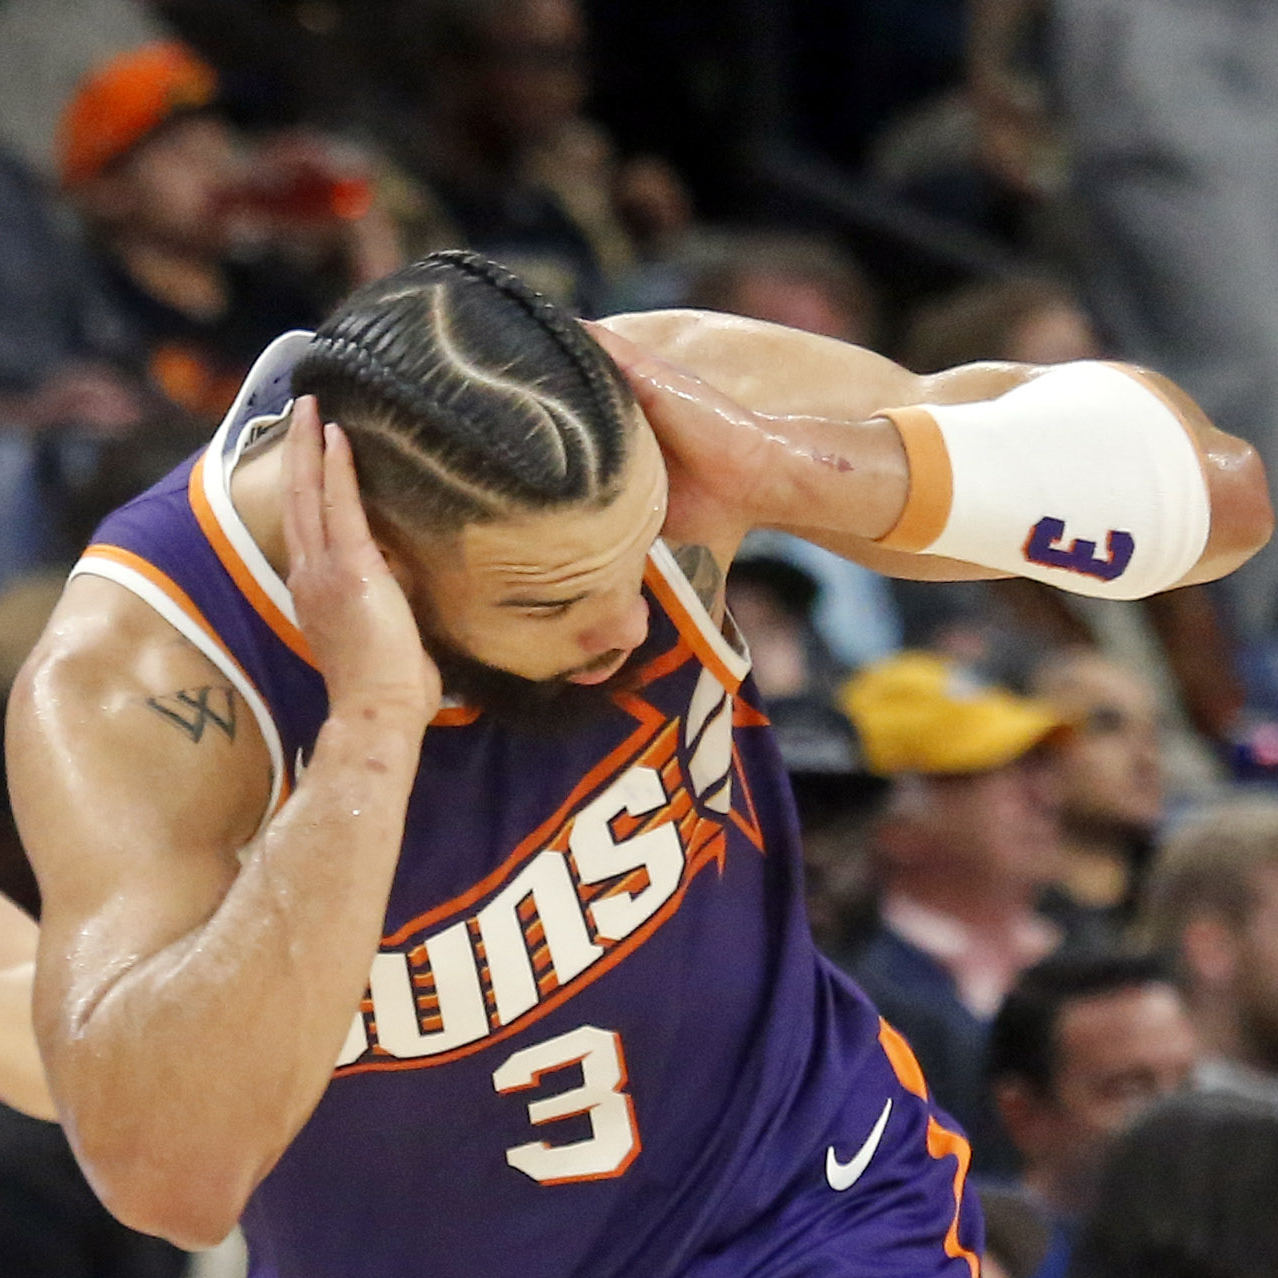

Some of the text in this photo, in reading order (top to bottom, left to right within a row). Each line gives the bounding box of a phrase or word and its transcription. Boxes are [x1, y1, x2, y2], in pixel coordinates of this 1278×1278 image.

[1022, 515, 1135, 584] 3
[334, 766, 685, 1067] UNS
[492, 1024, 642, 1186] 3
